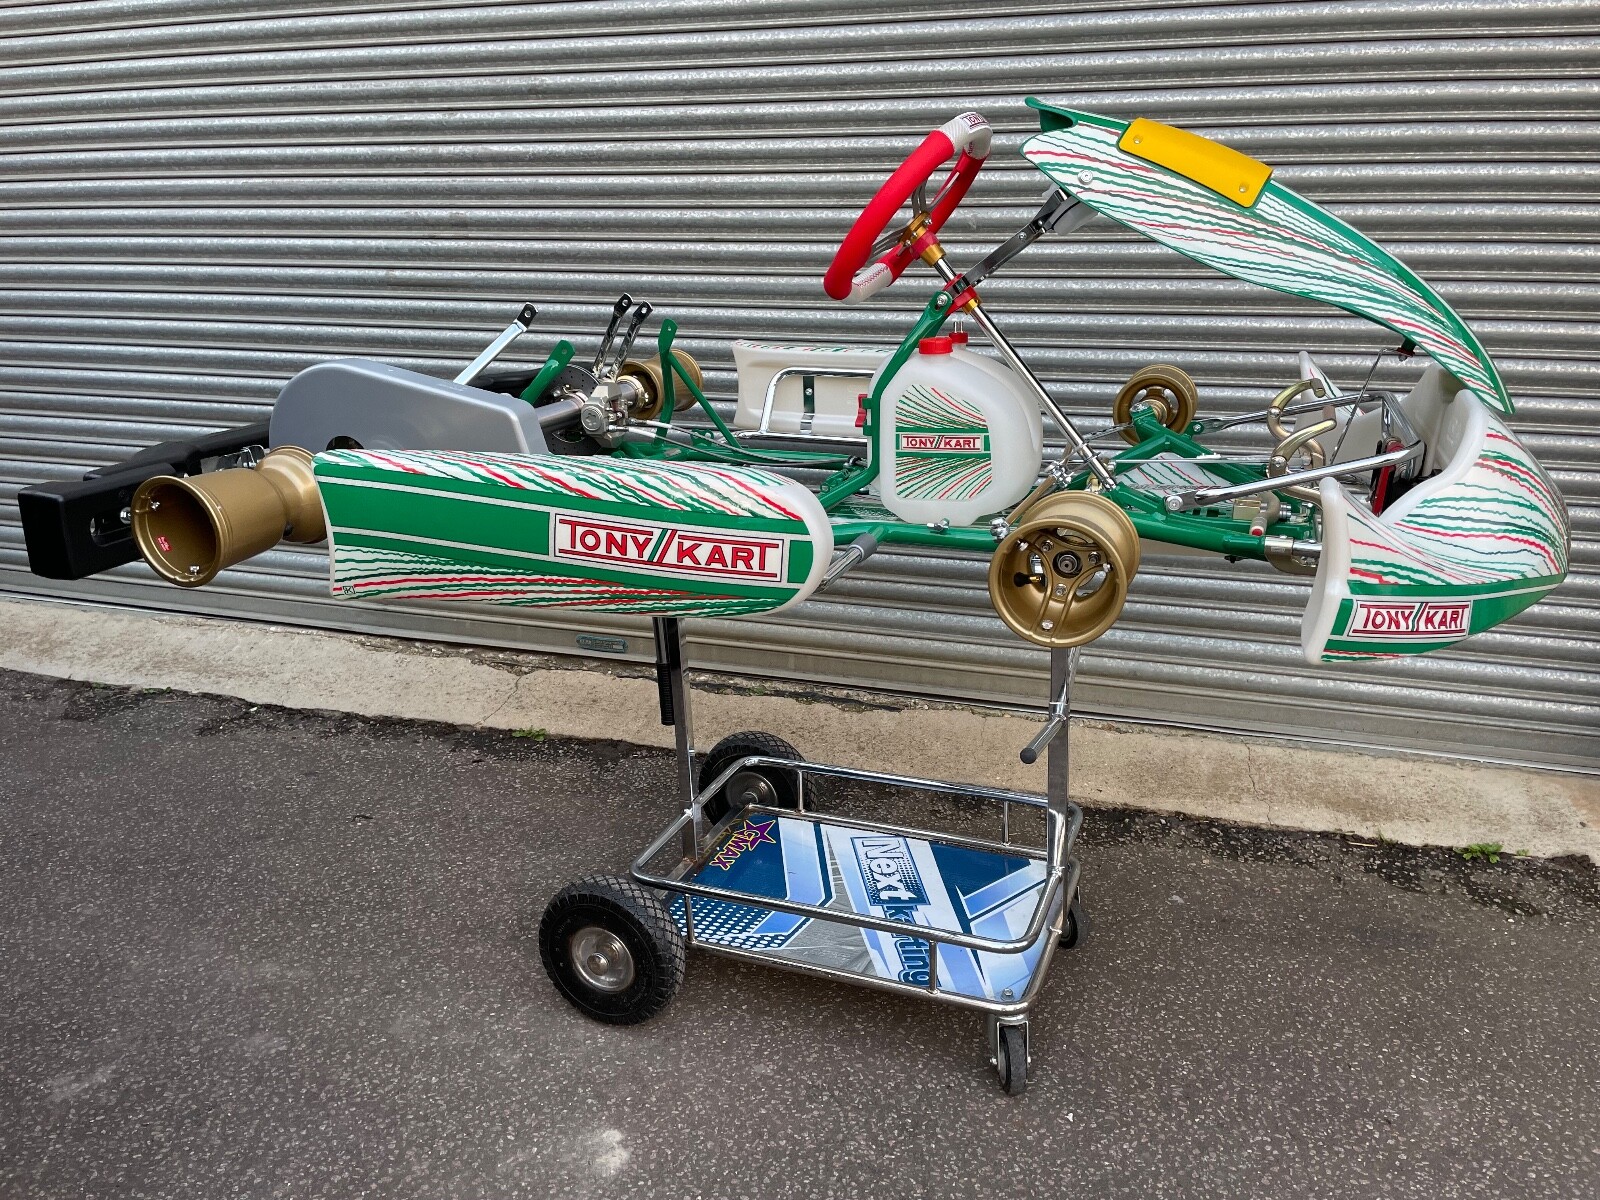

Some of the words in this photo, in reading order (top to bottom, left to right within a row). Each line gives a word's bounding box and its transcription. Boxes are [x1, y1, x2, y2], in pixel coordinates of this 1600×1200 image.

[903, 435, 937, 448] TONY
[943, 436, 981, 448] KART
[559, 519, 654, 559] TONY
[676, 534, 780, 571] KART
[1359, 604, 1415, 630] TONY
[1424, 604, 1470, 630] KART
[862, 839, 918, 900] Next
[884, 905, 934, 987] kting
